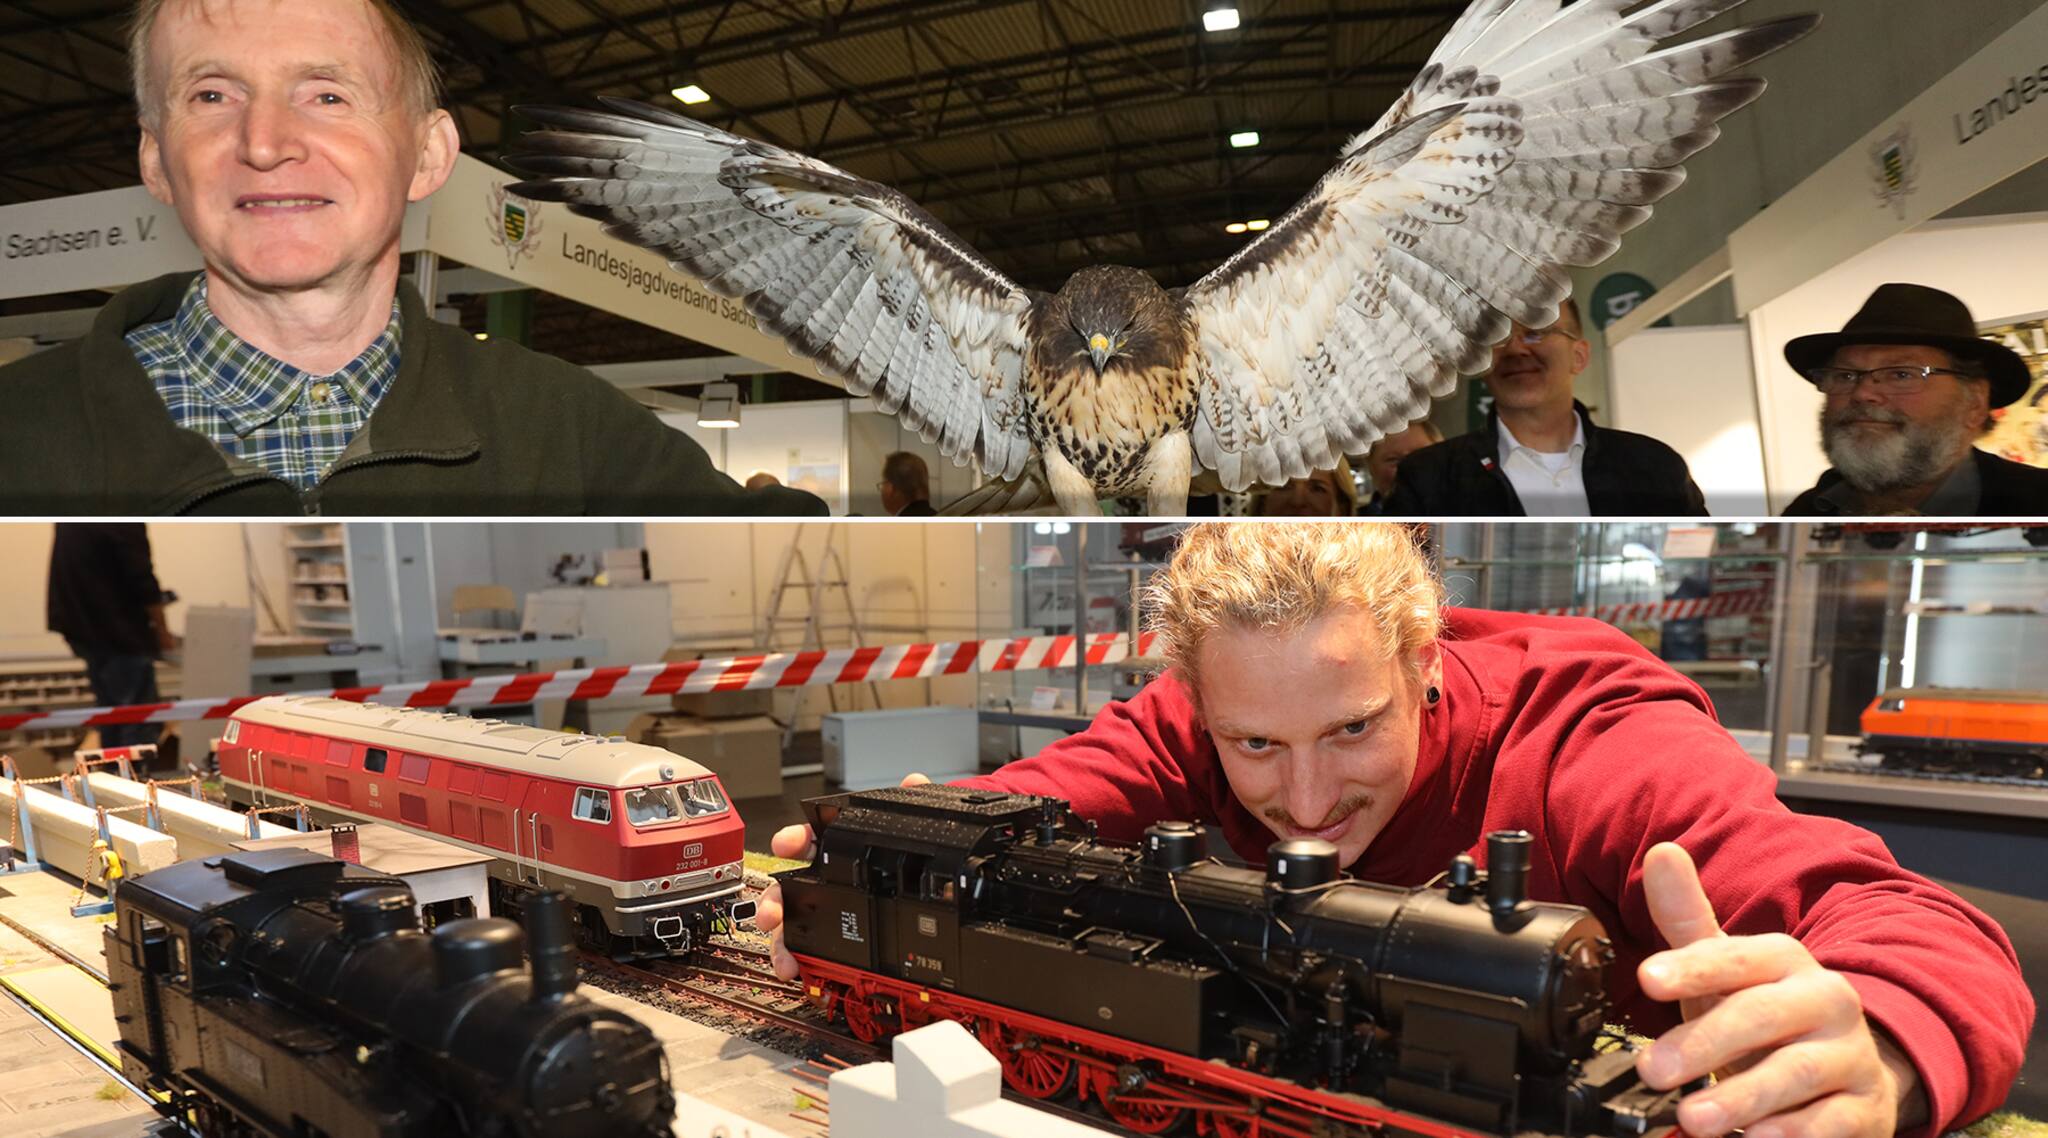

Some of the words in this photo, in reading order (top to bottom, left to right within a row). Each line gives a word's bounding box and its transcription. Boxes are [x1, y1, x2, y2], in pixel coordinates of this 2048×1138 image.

[6, 230, 101, 259] Sachsen
[106, 226, 128, 246] e.
[136, 214, 157, 241] V.
[562, 232, 718, 315] Landesjagdverband
